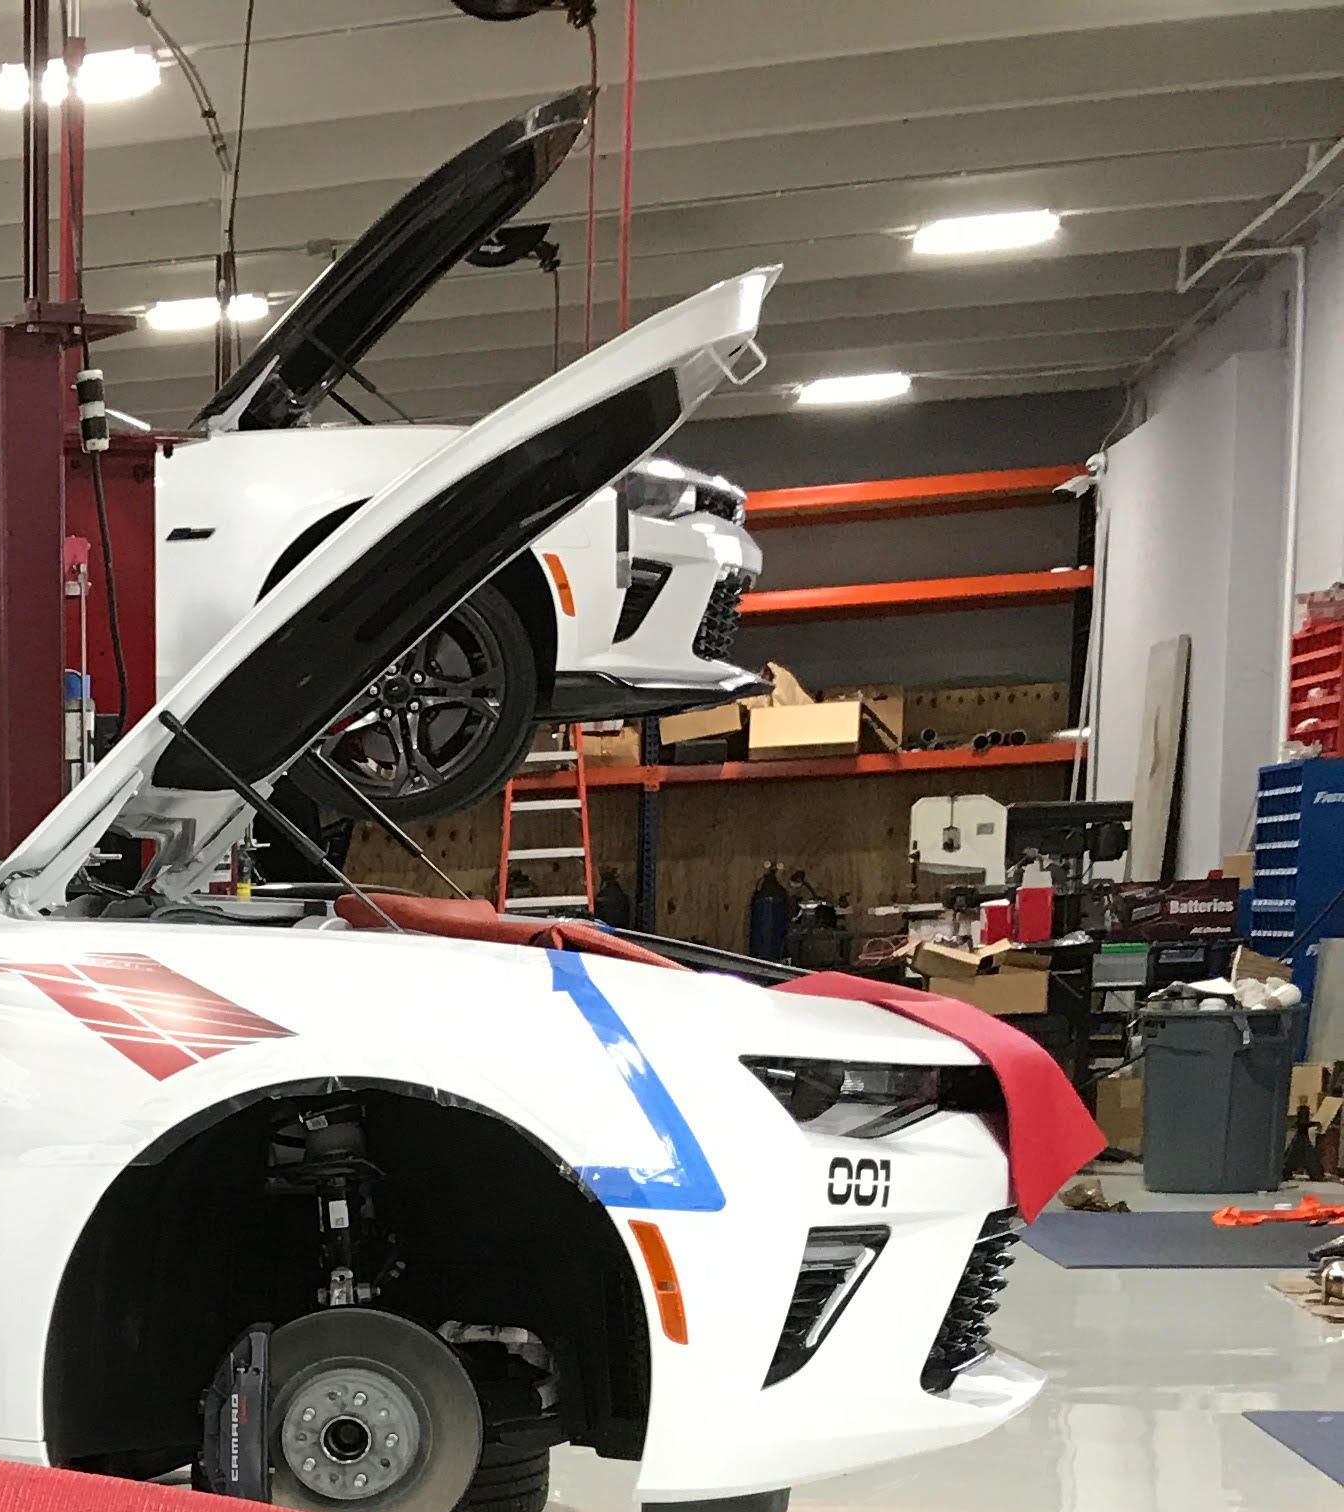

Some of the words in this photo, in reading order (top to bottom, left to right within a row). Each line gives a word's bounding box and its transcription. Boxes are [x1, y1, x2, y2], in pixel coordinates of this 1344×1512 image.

[1169, 898, 1234, 914] Batteries
[827, 1157, 891, 1208] 001
[231, 1393, 239, 1482] CAMARO
